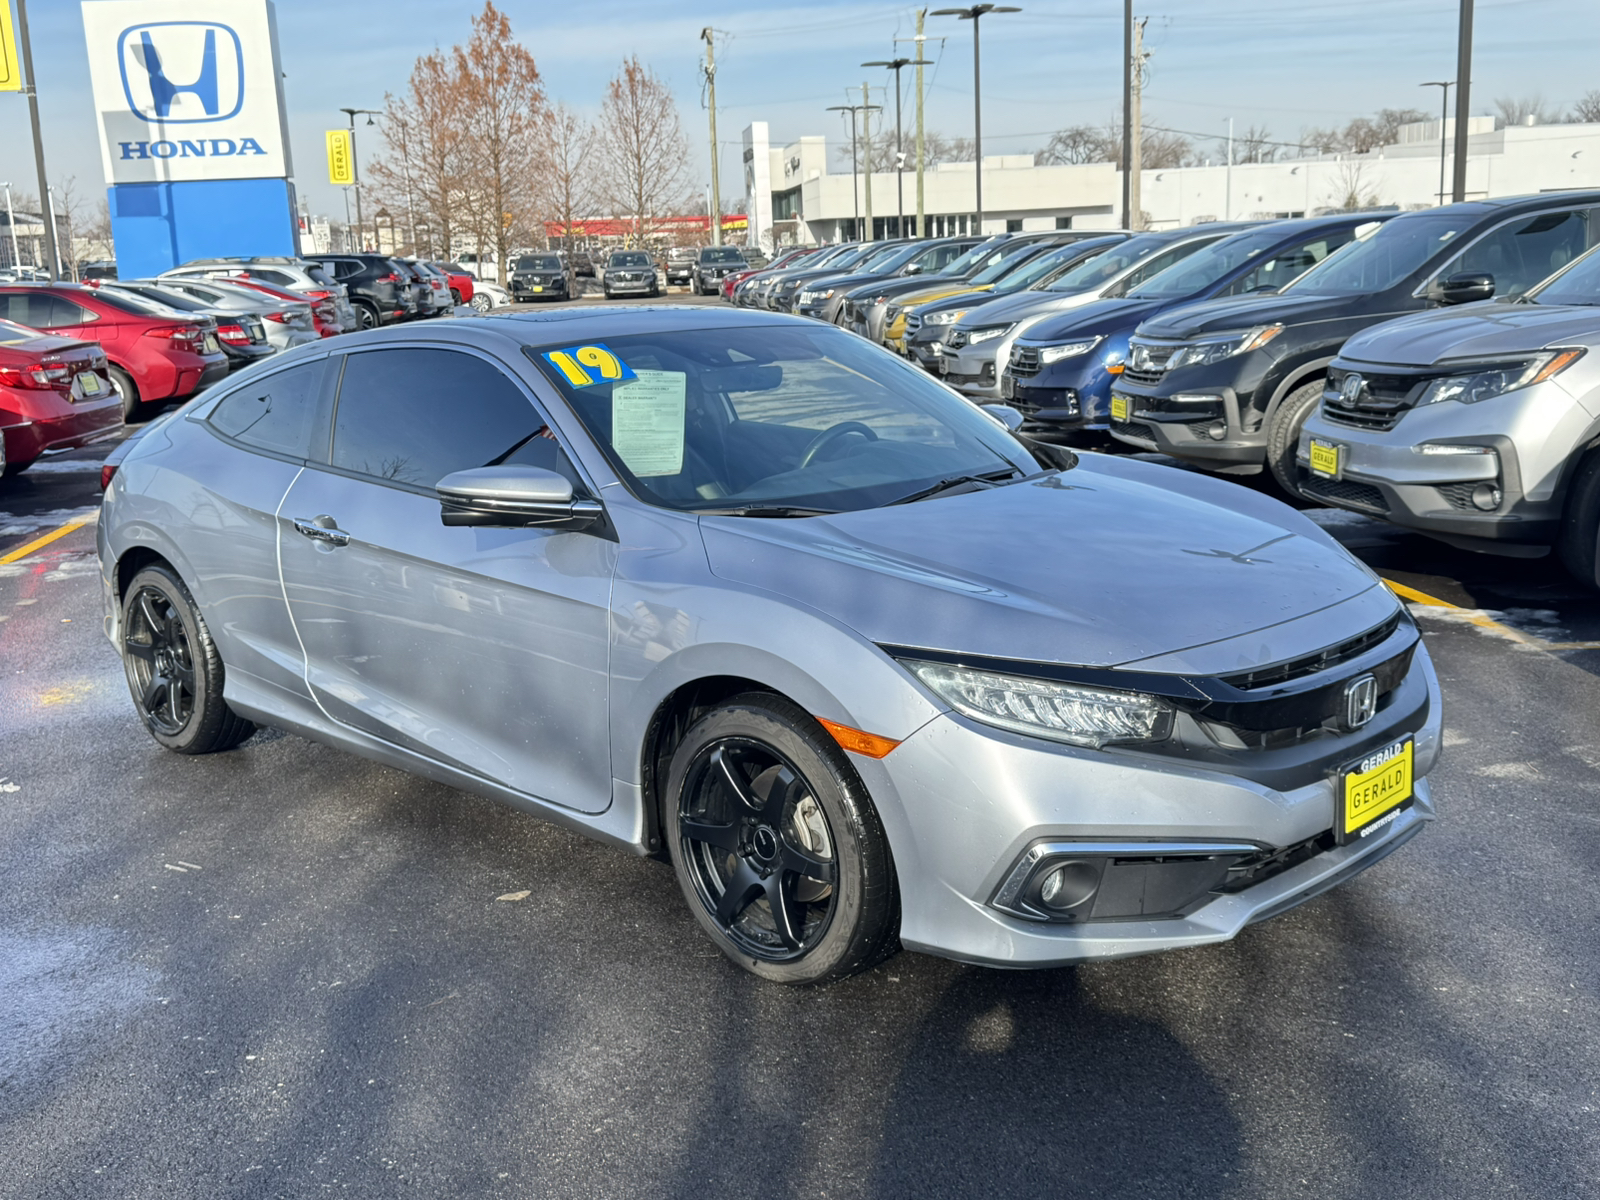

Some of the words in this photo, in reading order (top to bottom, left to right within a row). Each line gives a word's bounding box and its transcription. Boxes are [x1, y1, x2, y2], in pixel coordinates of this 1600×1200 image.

[118, 138, 268, 160] HONDA
[335, 137, 345, 177] GERALD
[548, 346, 623, 386] 19
[1313, 452, 1334, 465] GERALD
[1361, 742, 1402, 772] GERALD
[1353, 770, 1402, 809] GERALD
[1360, 808, 1401, 838] COUNTRYSIDE
